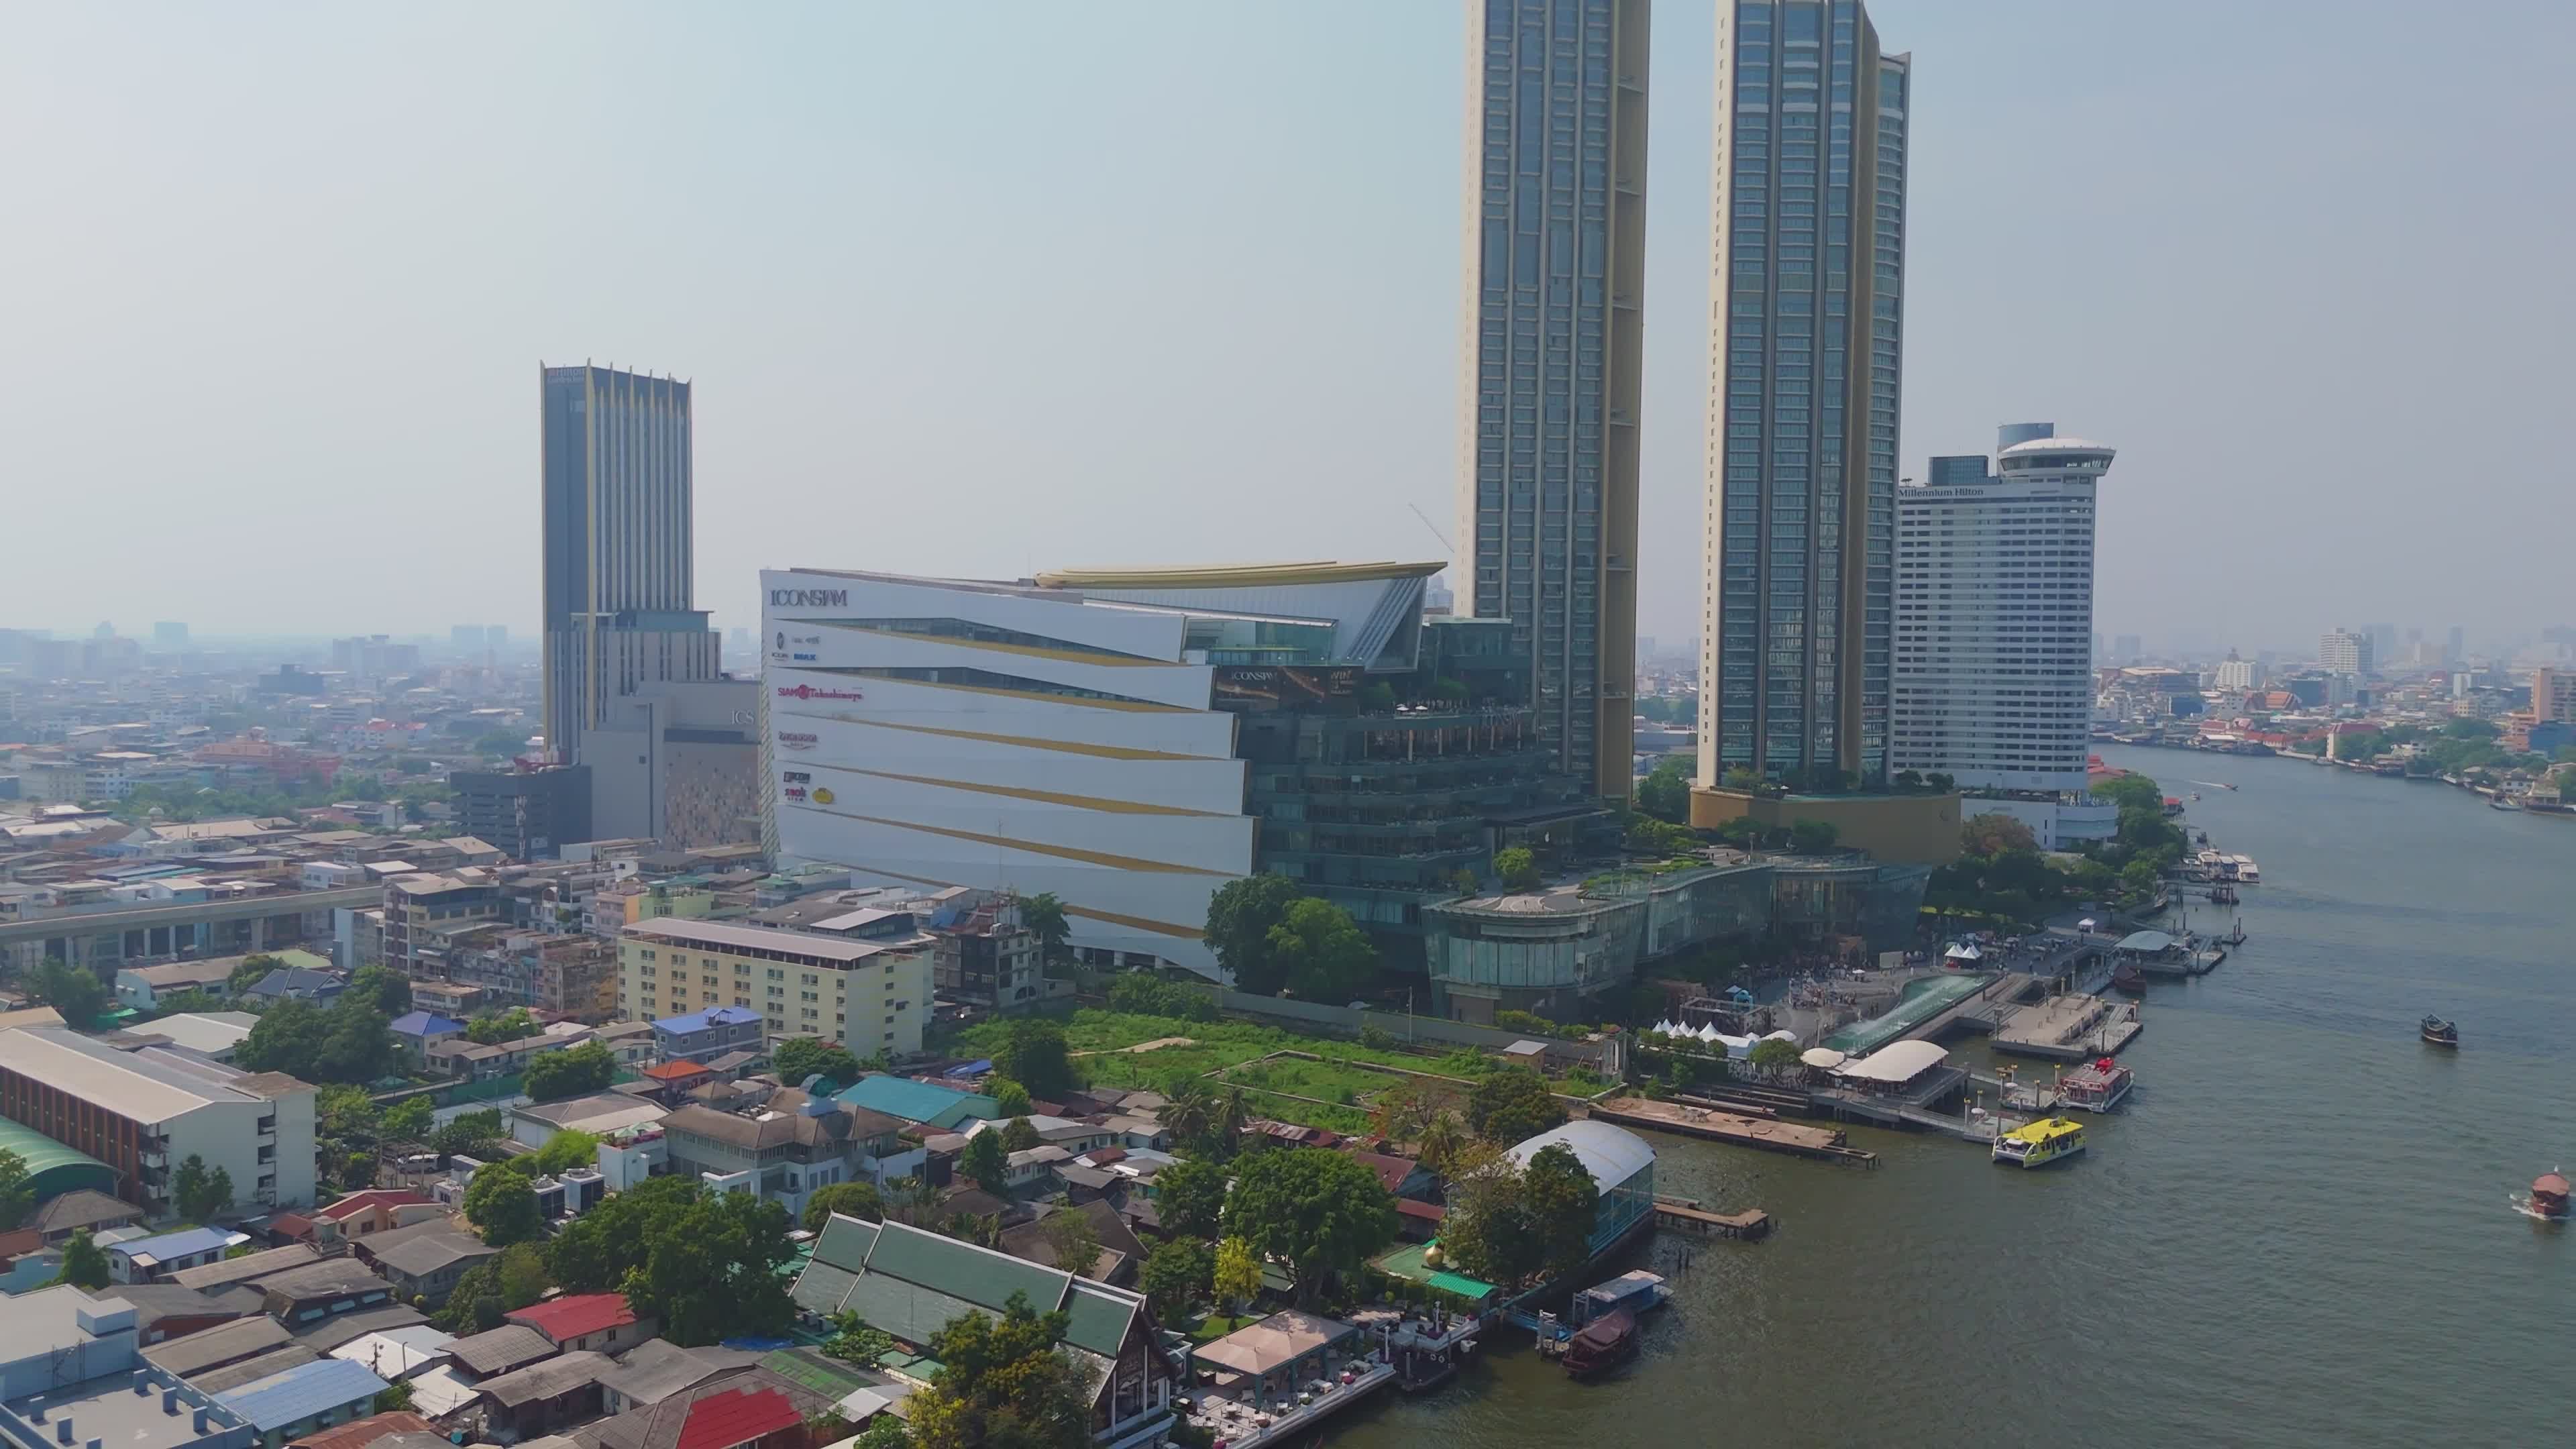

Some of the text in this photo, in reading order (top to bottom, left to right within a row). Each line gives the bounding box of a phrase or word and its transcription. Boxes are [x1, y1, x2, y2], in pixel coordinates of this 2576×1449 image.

[1899, 488, 1984, 498] Millennium Hilton
[770, 590, 848, 606] ICONSIAM
[778, 688, 799, 697] SIAM
[730, 708, 755, 724] ICS
